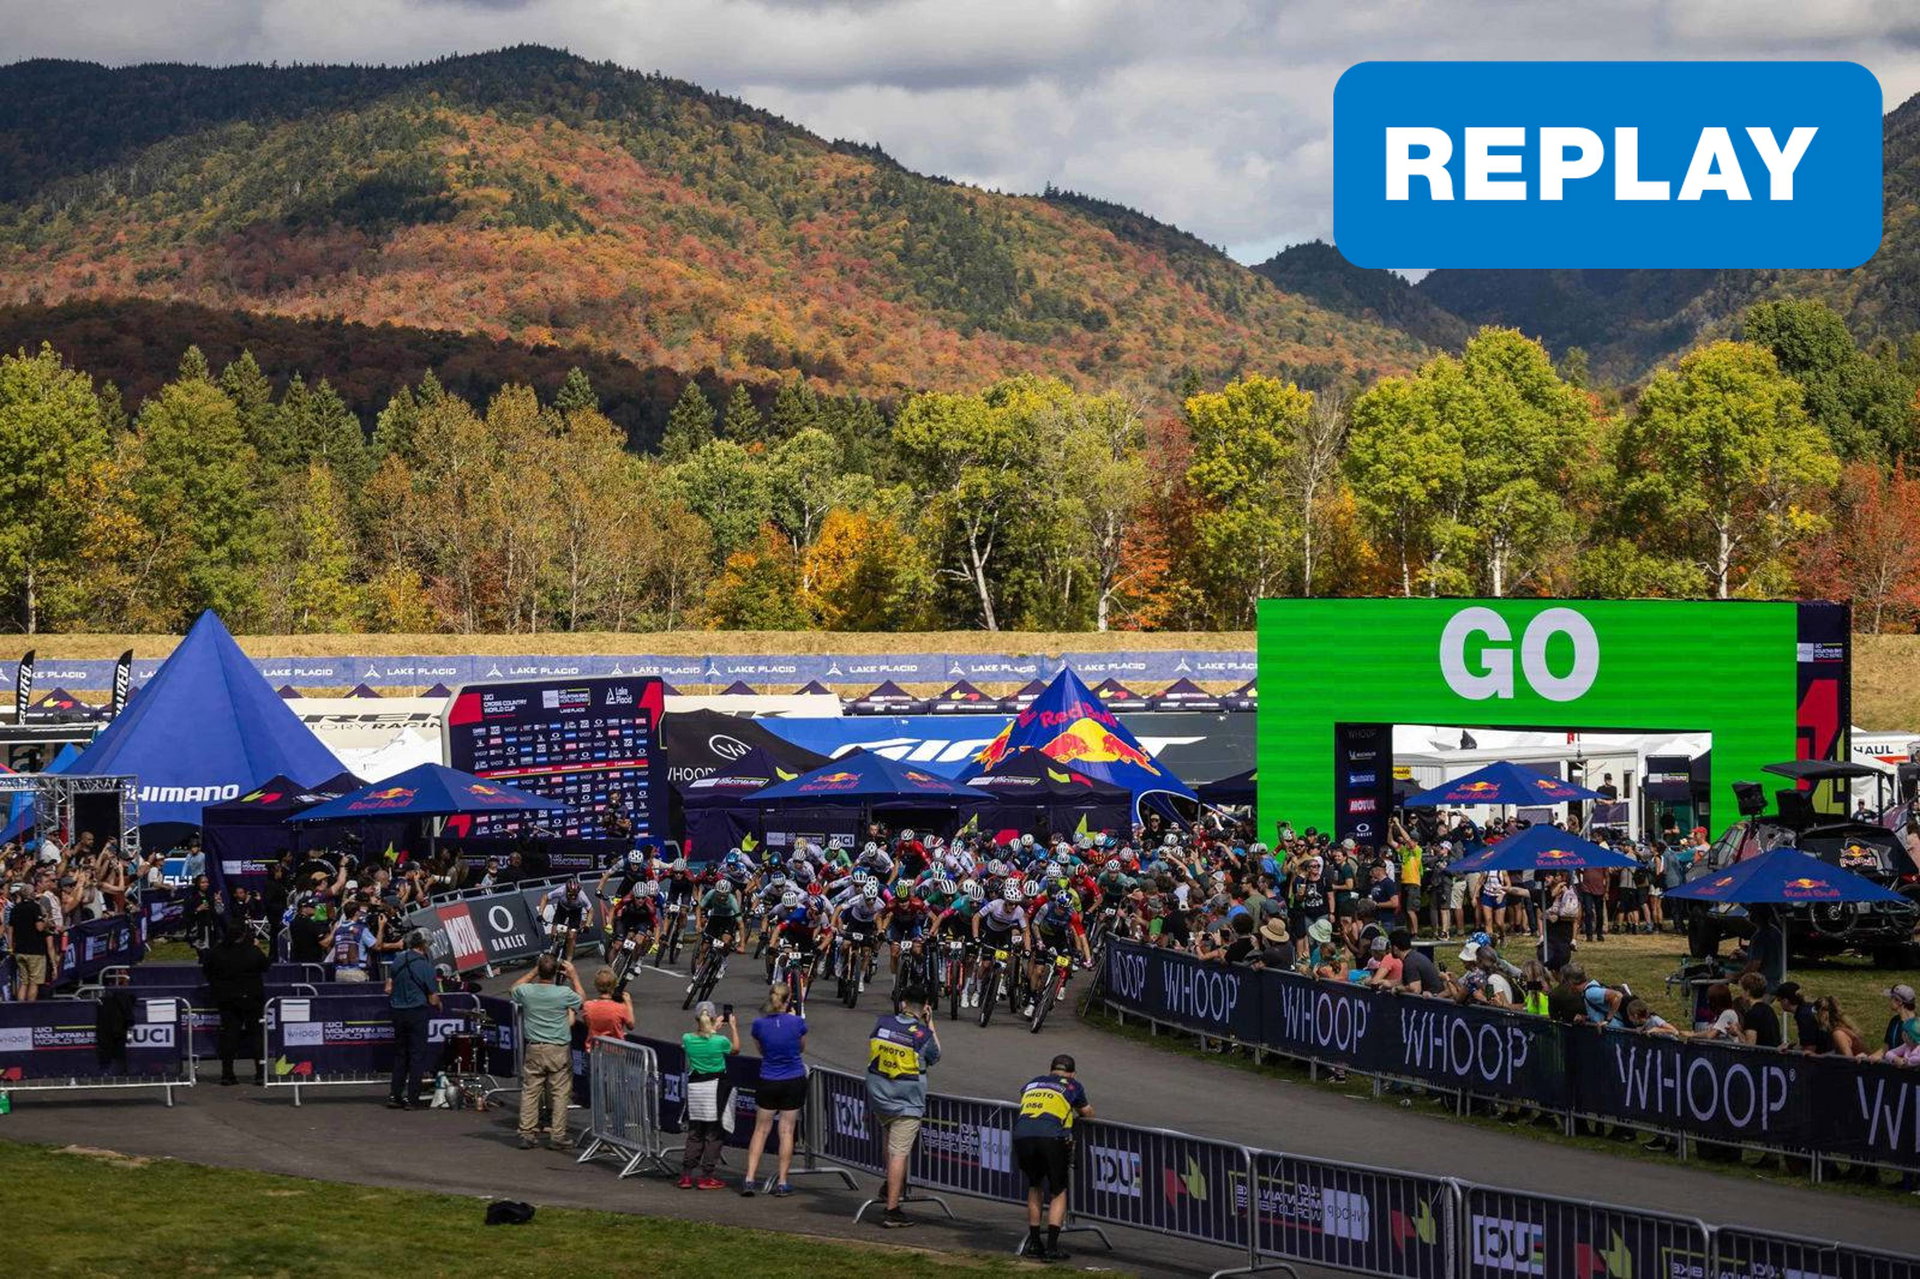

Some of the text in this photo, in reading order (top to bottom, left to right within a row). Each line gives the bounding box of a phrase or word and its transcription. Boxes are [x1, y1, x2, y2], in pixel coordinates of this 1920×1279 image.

[1440, 606, 1599, 702] GO
[510, 666, 579, 675] LAKE PLACID
[632, 666, 700, 674] LAKE PLACID
[727, 665, 796, 673] LAKE PLACID
[850, 664, 918, 673] LAKE PLACID
[971, 664, 1037, 674] LAKE PLACID
[1078, 662, 1146, 672] LAKE PLACID
[1197, 662, 1257, 670] LAKE PLACI
[48, 671, 87, 679] PLACID
[294, 668, 334, 676] PLACID
[418, 667, 456, 675] PLACID
[371, 722, 441, 730] RACIN
[491, 934, 528, 951] OAKLEY
[1163, 961, 1238, 1024] WHOOP
[1281, 984, 1367, 1055] WHOOP
[133, 1029, 170, 1043] UCI
[287, 1031, 320, 1039] WHOOP
[878, 1044, 906, 1058] PHOTO
[1402, 1007, 1529, 1086] WHOOP
[1025, 1090, 1054, 1099] PHOTO
